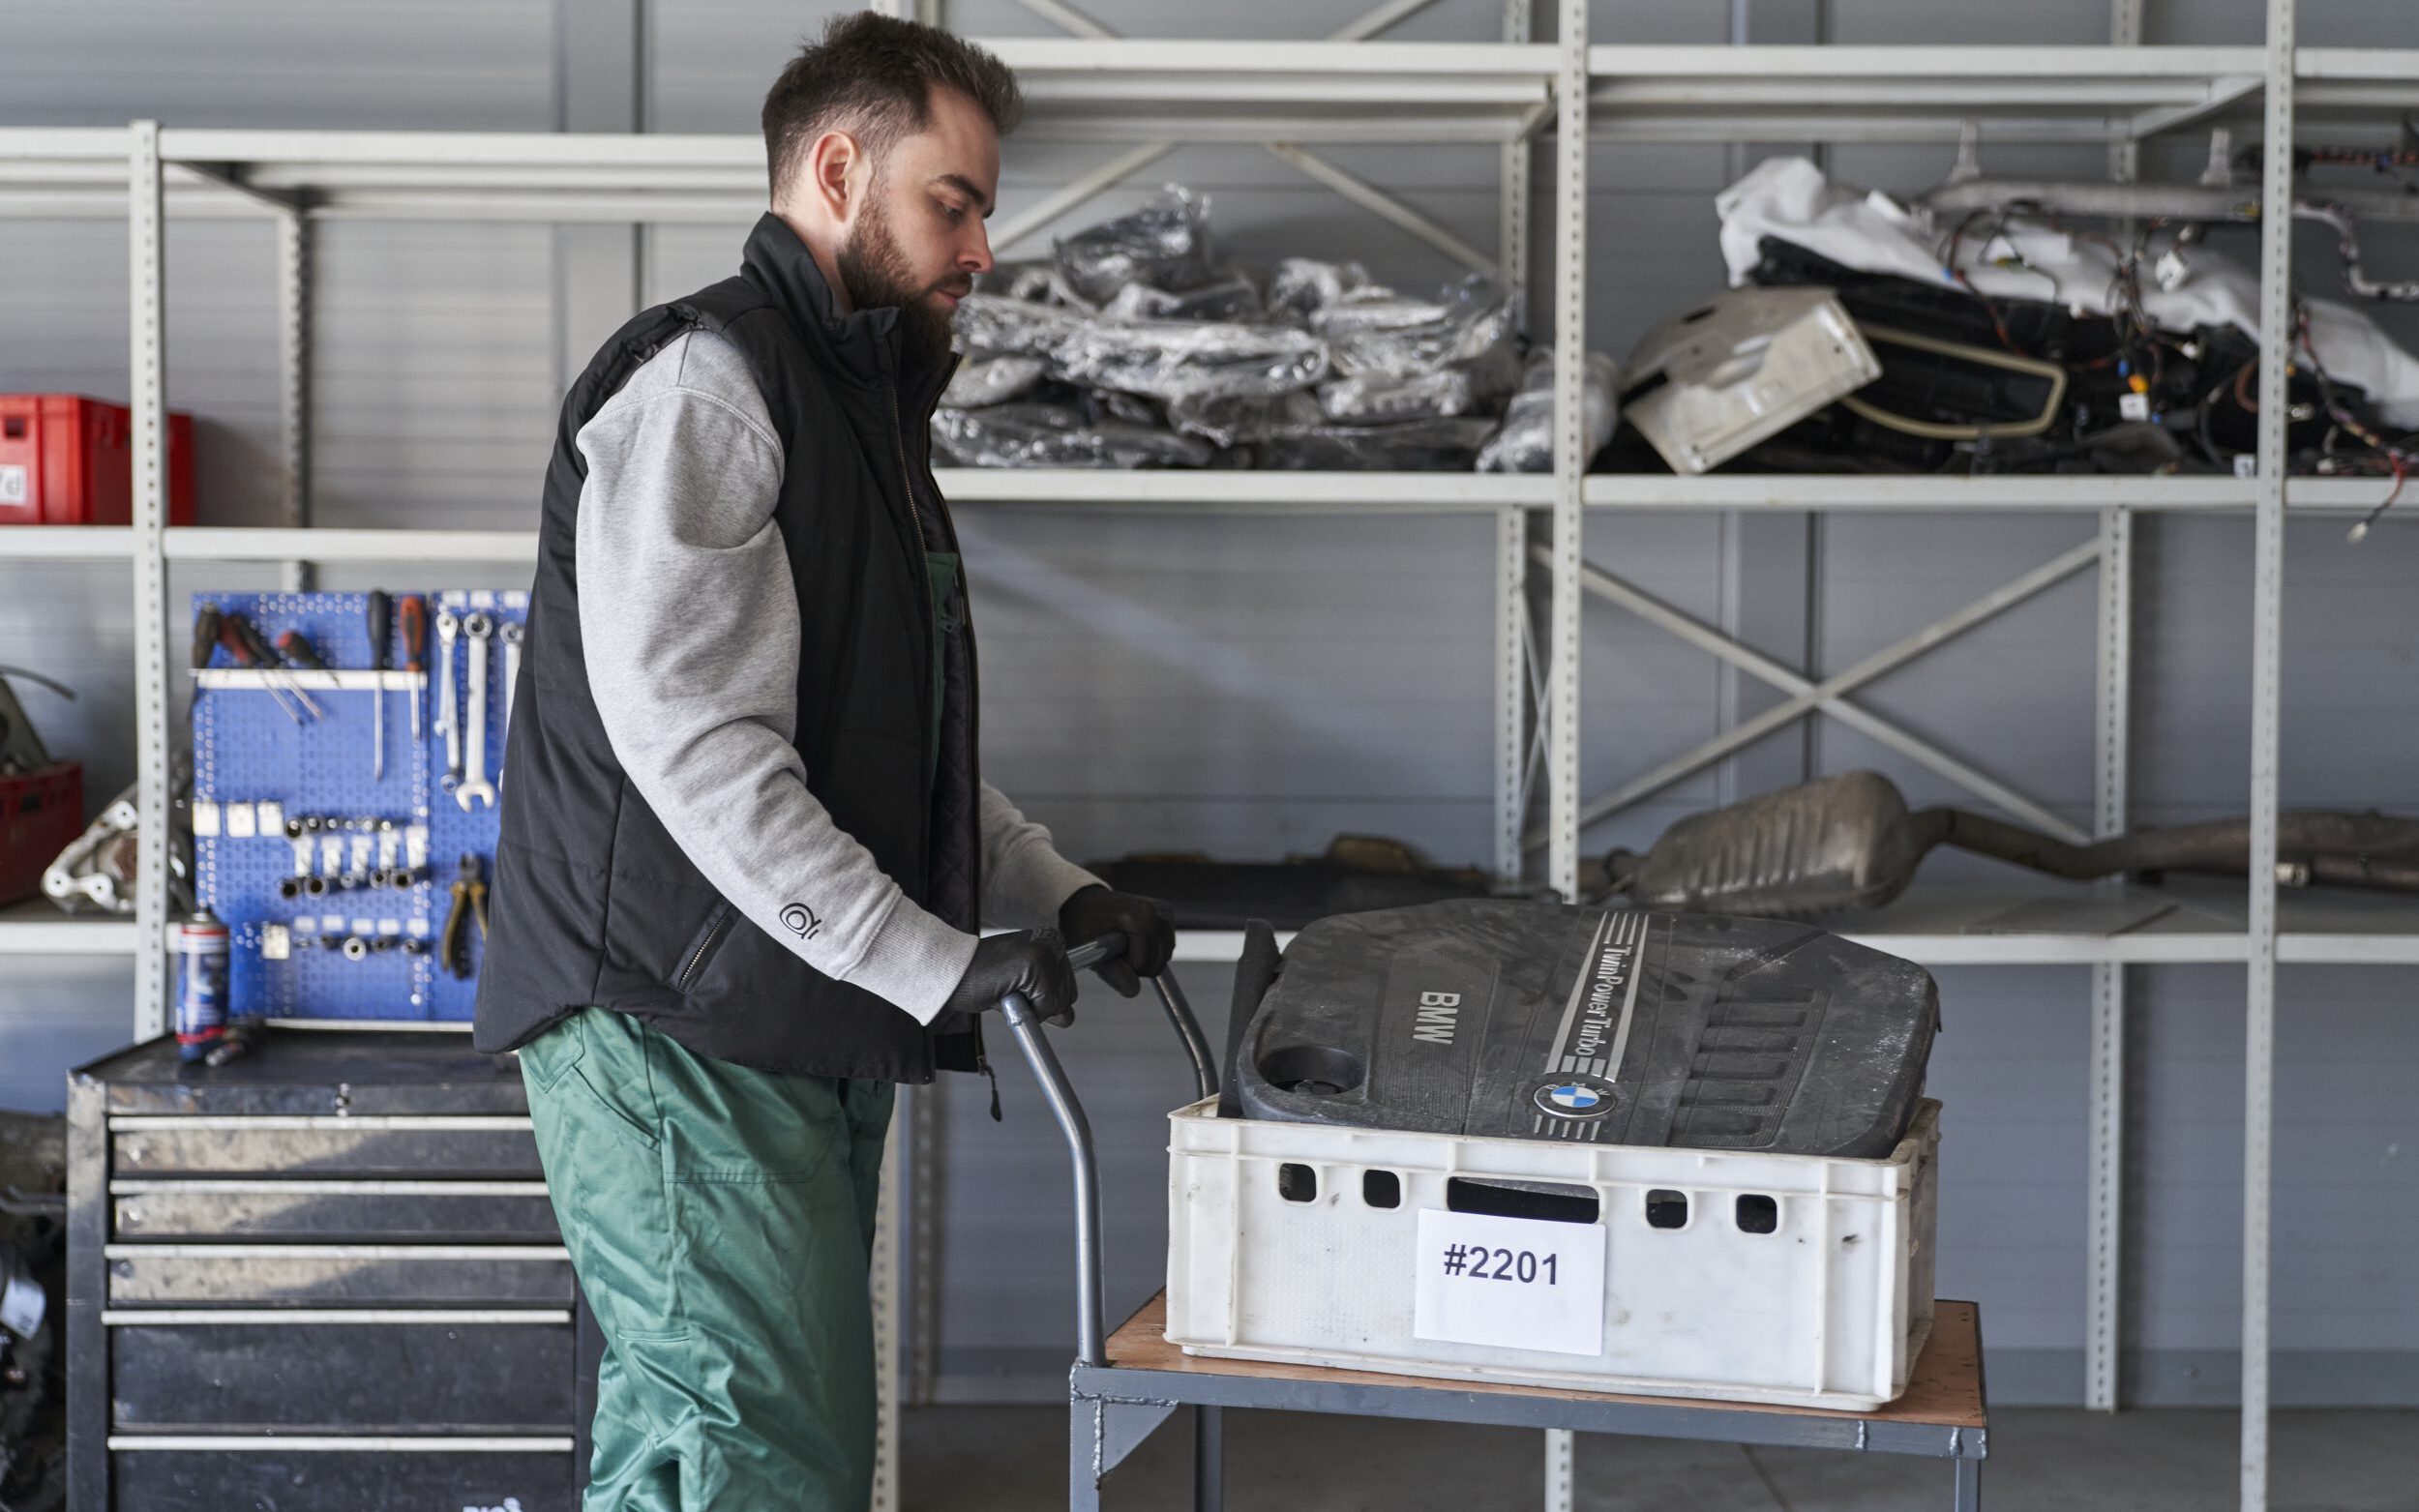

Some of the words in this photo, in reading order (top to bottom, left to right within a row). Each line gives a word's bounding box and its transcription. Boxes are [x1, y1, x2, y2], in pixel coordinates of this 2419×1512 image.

[1413, 991, 1461, 1045] BMW
[1574, 1018, 1613, 1056] Turbo
[1544, 1082, 1610, 1096] BMW
[1444, 1243, 1557, 1286] #2201
